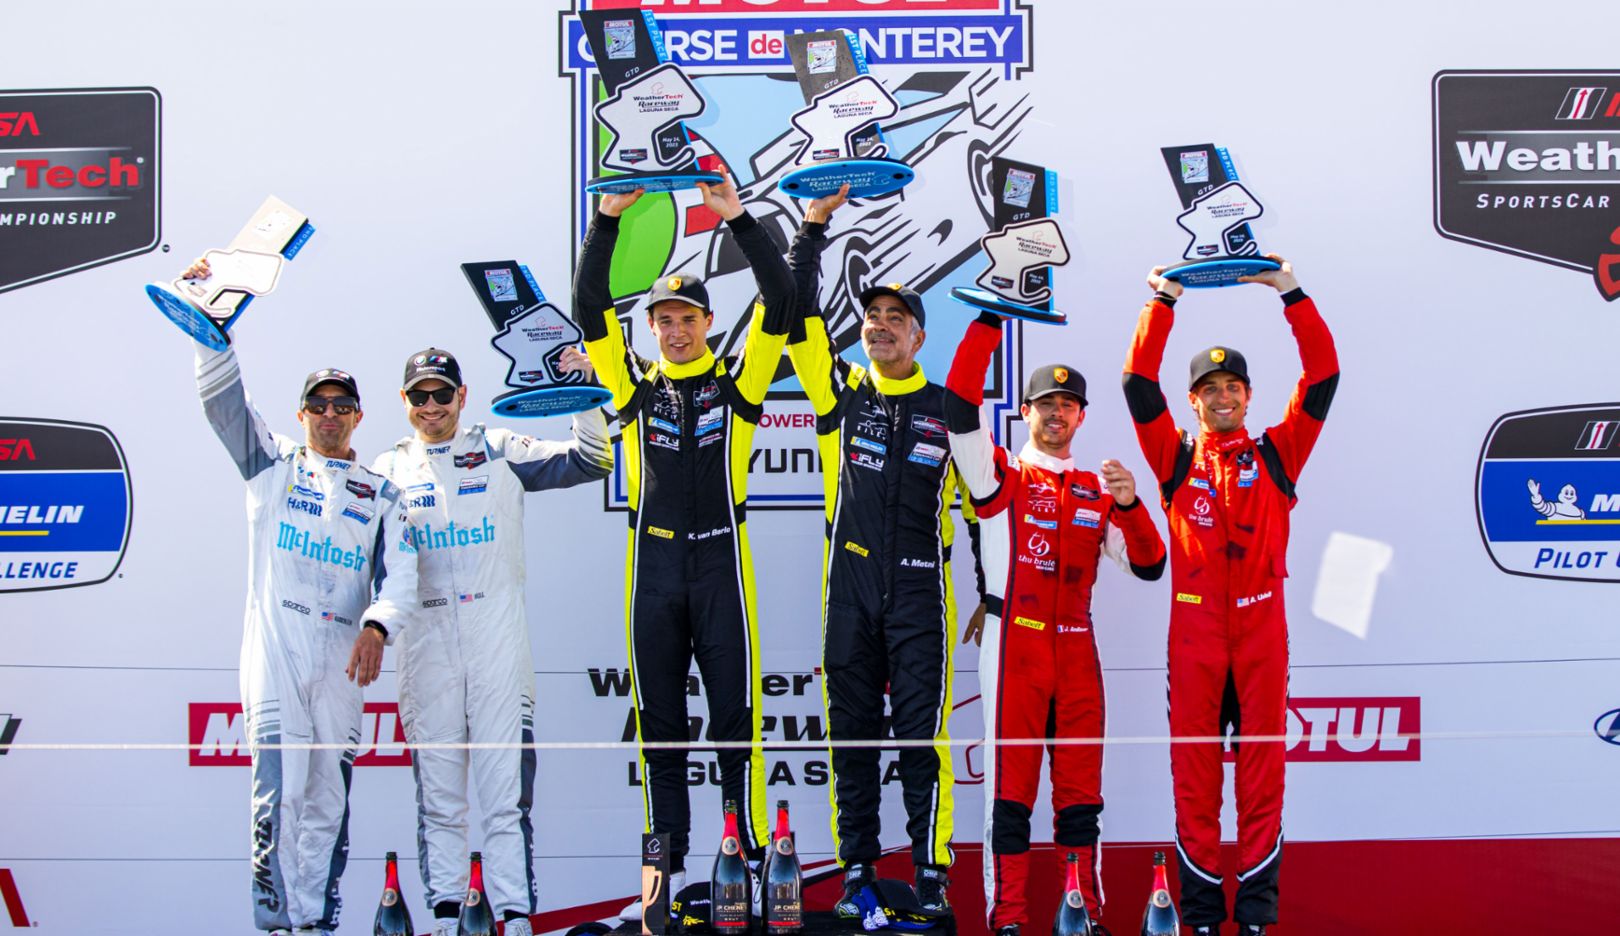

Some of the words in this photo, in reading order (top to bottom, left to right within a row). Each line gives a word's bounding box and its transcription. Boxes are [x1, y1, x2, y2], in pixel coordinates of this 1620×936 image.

[577, 28, 737, 62] CRSE
[750, 33, 782, 54] de
[794, 26, 1015, 60] NTEREY
[653, 31, 667, 58] PLACE
[625, 66, 640, 78] GTD
[638, 100, 680, 108] Raceway
[759, 414, 815, 428] OWER
[858, 453, 885, 468] iFLY
[277, 521, 367, 572] McIntosh
[900, 558, 910, 567] A.
[911, 559, 935, 569] Metni
[1534, 548, 1608, 568] PILOT
[0, 562, 78, 578] LENGE
[199, 712, 409, 757] MUL
